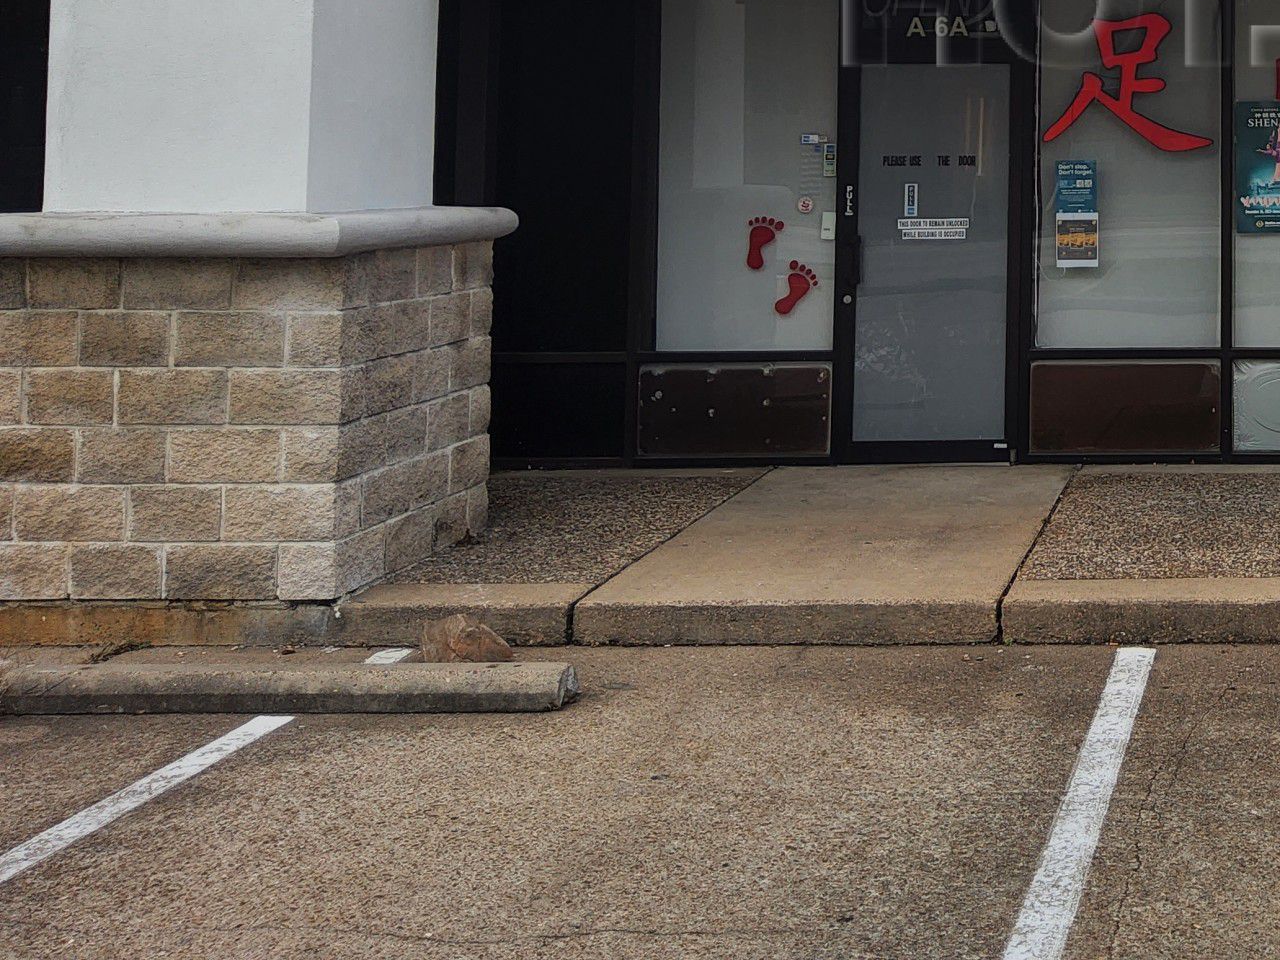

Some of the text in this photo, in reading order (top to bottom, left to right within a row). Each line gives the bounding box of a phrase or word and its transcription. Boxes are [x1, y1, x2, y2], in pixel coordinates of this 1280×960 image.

[935, 16, 968, 37] 6A
[1043, 12, 1213, 152] 足
[1248, 118, 1279, 127] SHEN
[883, 155, 976, 167] PLEASE USE THE DOOR
